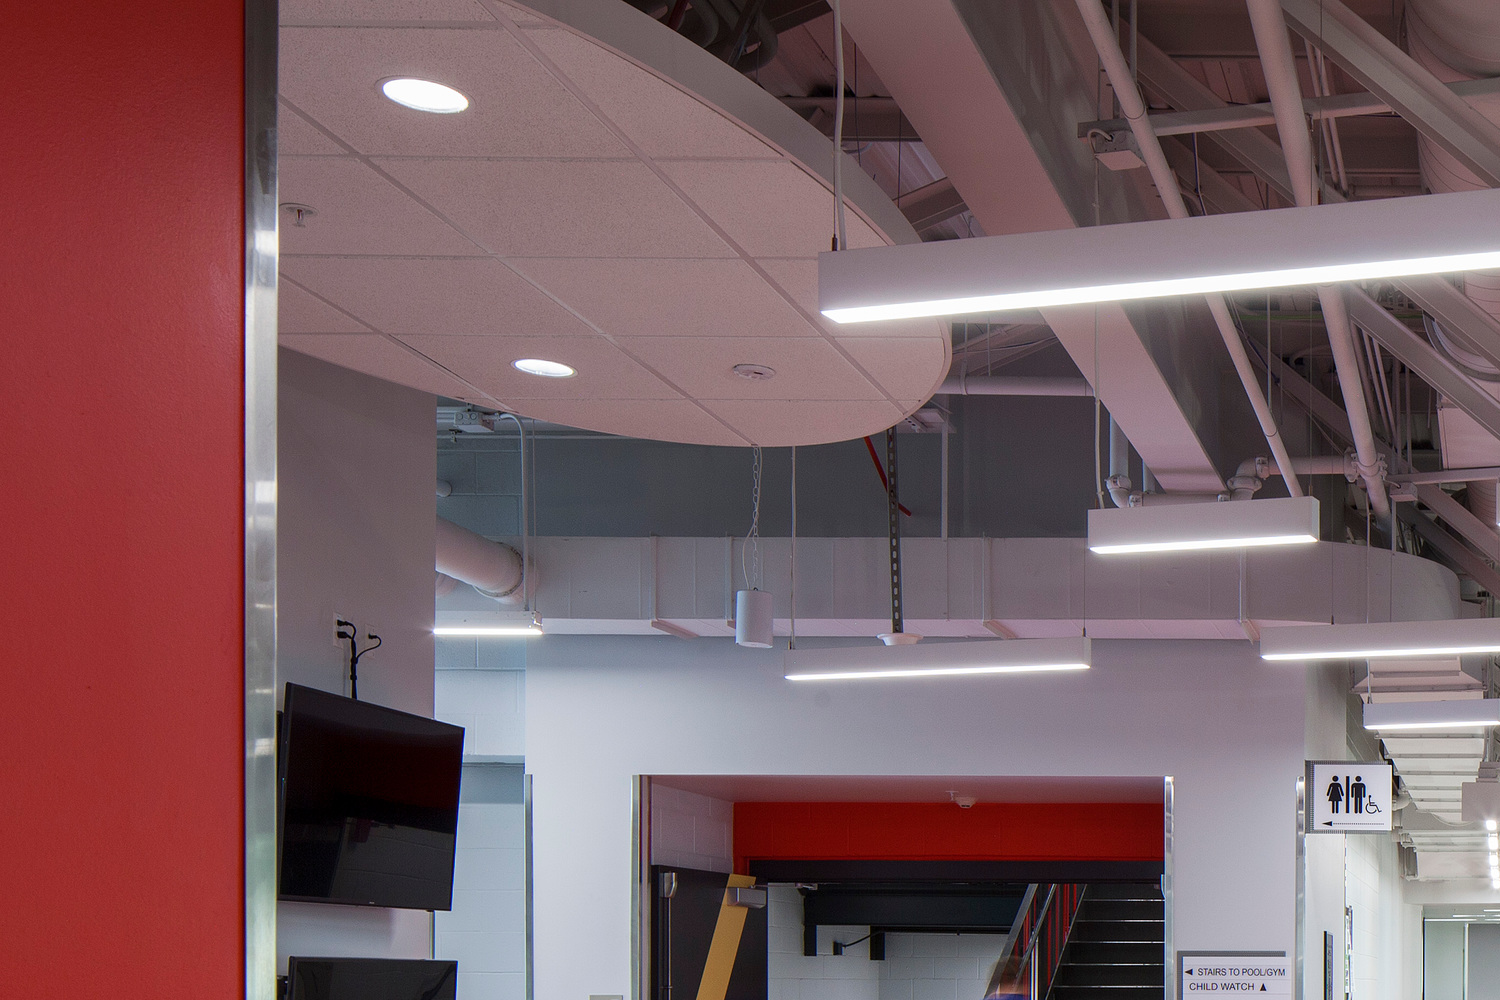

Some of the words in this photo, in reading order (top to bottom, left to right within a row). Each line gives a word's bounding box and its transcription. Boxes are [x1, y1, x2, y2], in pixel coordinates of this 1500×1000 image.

[1197, 968, 1227, 977] STAIRS
[1228, 968, 1240, 977] TO
[1241, 968, 1286, 977] POOL/GYM
[1189, 982, 1218, 991] CHILD
[1220, 982, 1255, 991] WATCH
